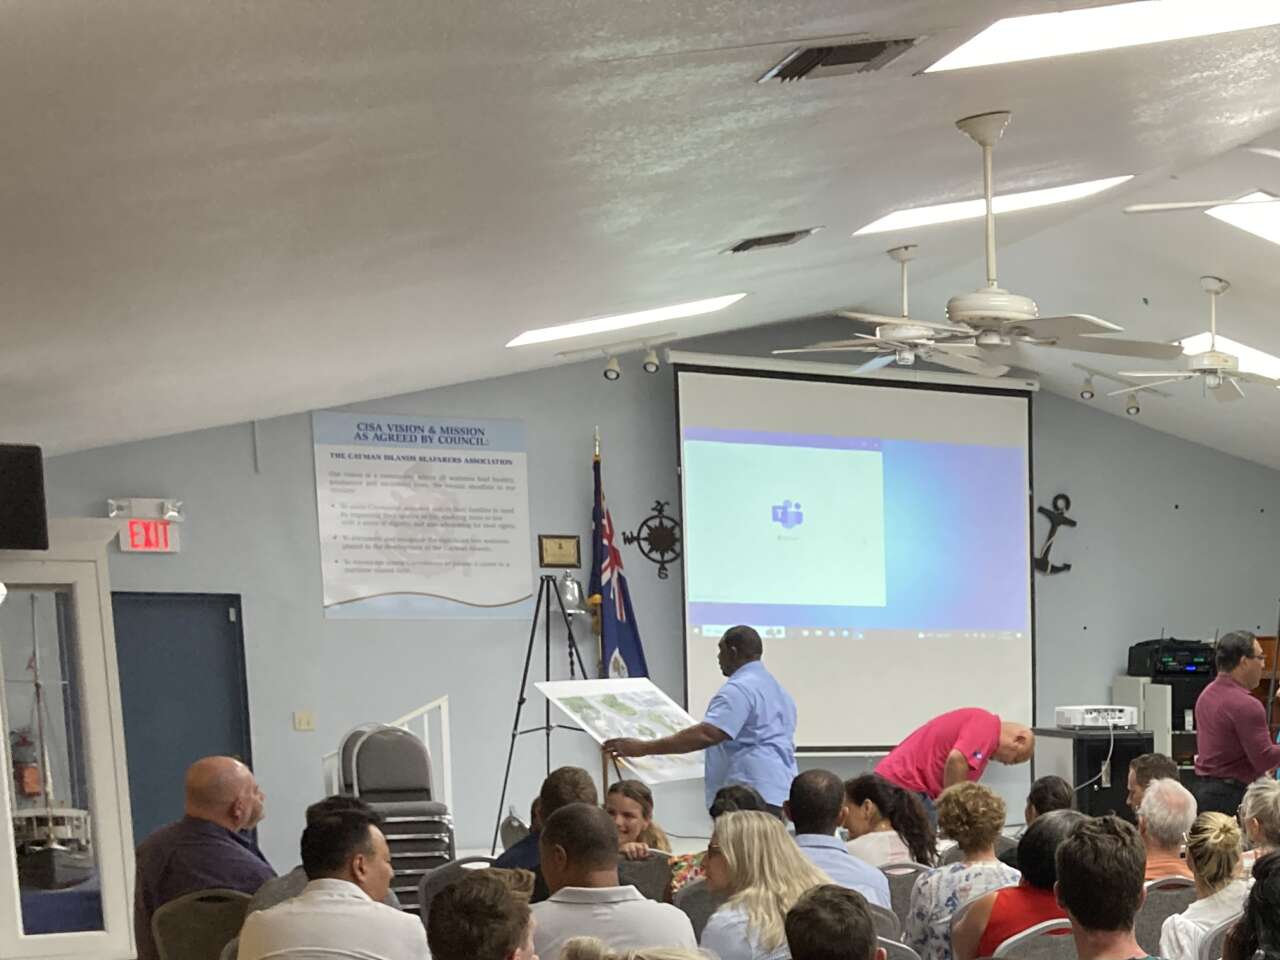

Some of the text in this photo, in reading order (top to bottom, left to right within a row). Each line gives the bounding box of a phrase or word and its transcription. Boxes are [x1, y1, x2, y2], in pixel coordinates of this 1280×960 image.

[356, 422, 486, 436] CISA VISION & MISSION
[354, 431, 369, 441] AS
[372, 432, 418, 443] AGREED
[421, 434, 434, 444] BY
[128, 519, 170, 548] EXIT
